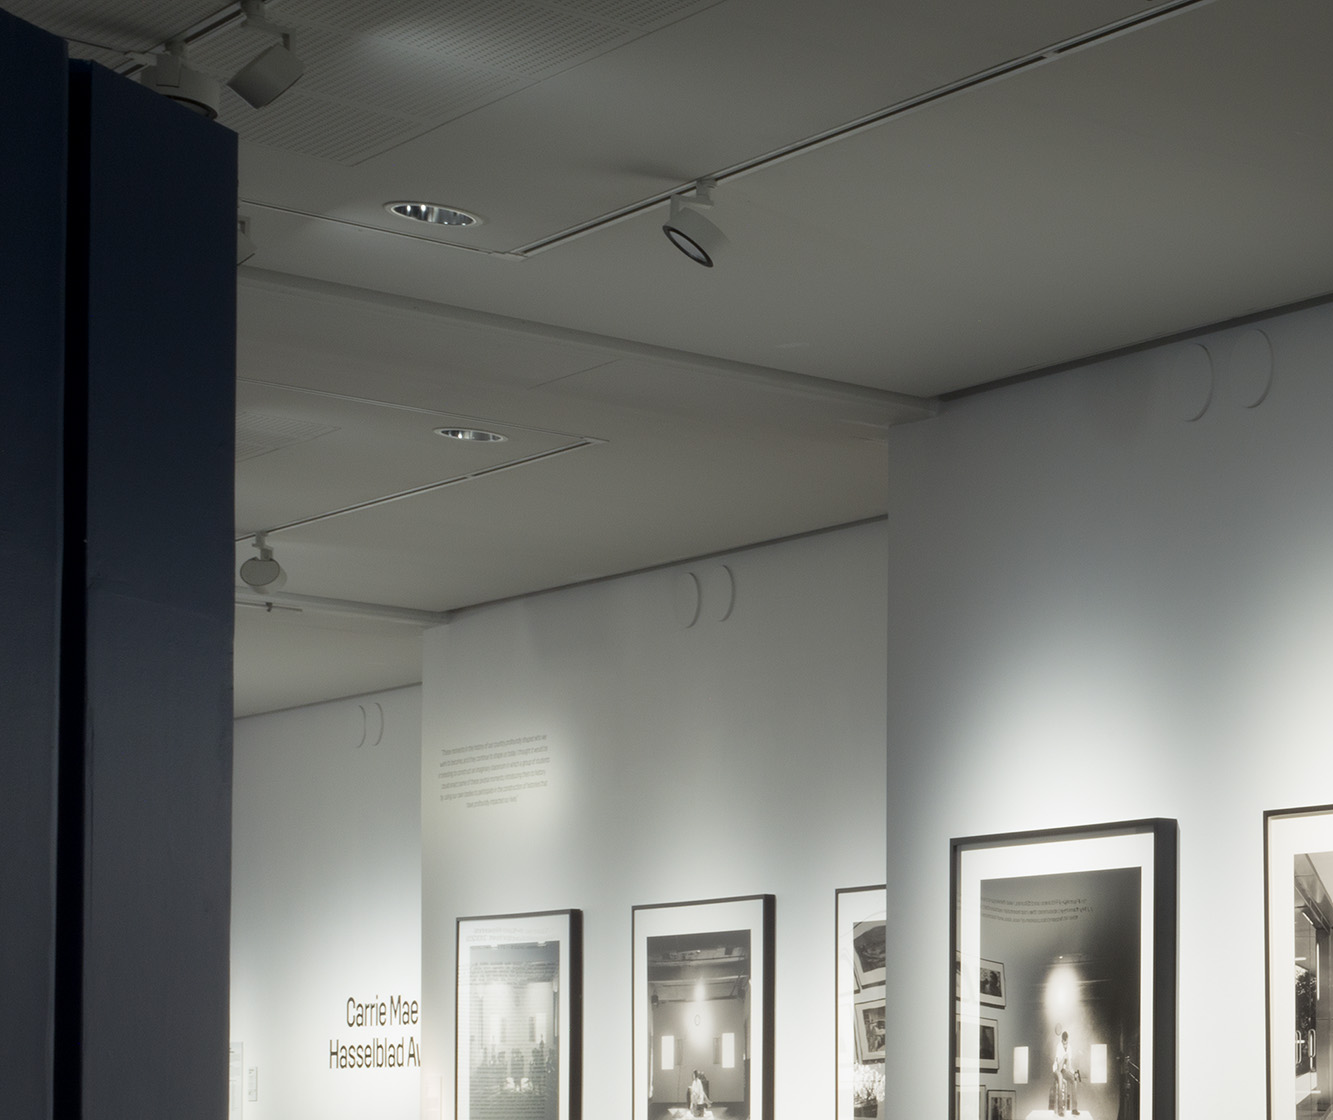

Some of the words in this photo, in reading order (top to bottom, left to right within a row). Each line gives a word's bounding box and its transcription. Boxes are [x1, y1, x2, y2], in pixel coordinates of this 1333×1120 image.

[346, 995, 387, 1027] Carrie
[390, 995, 419, 1026] Mae
[329, 1036, 404, 1069] Hasselblad
